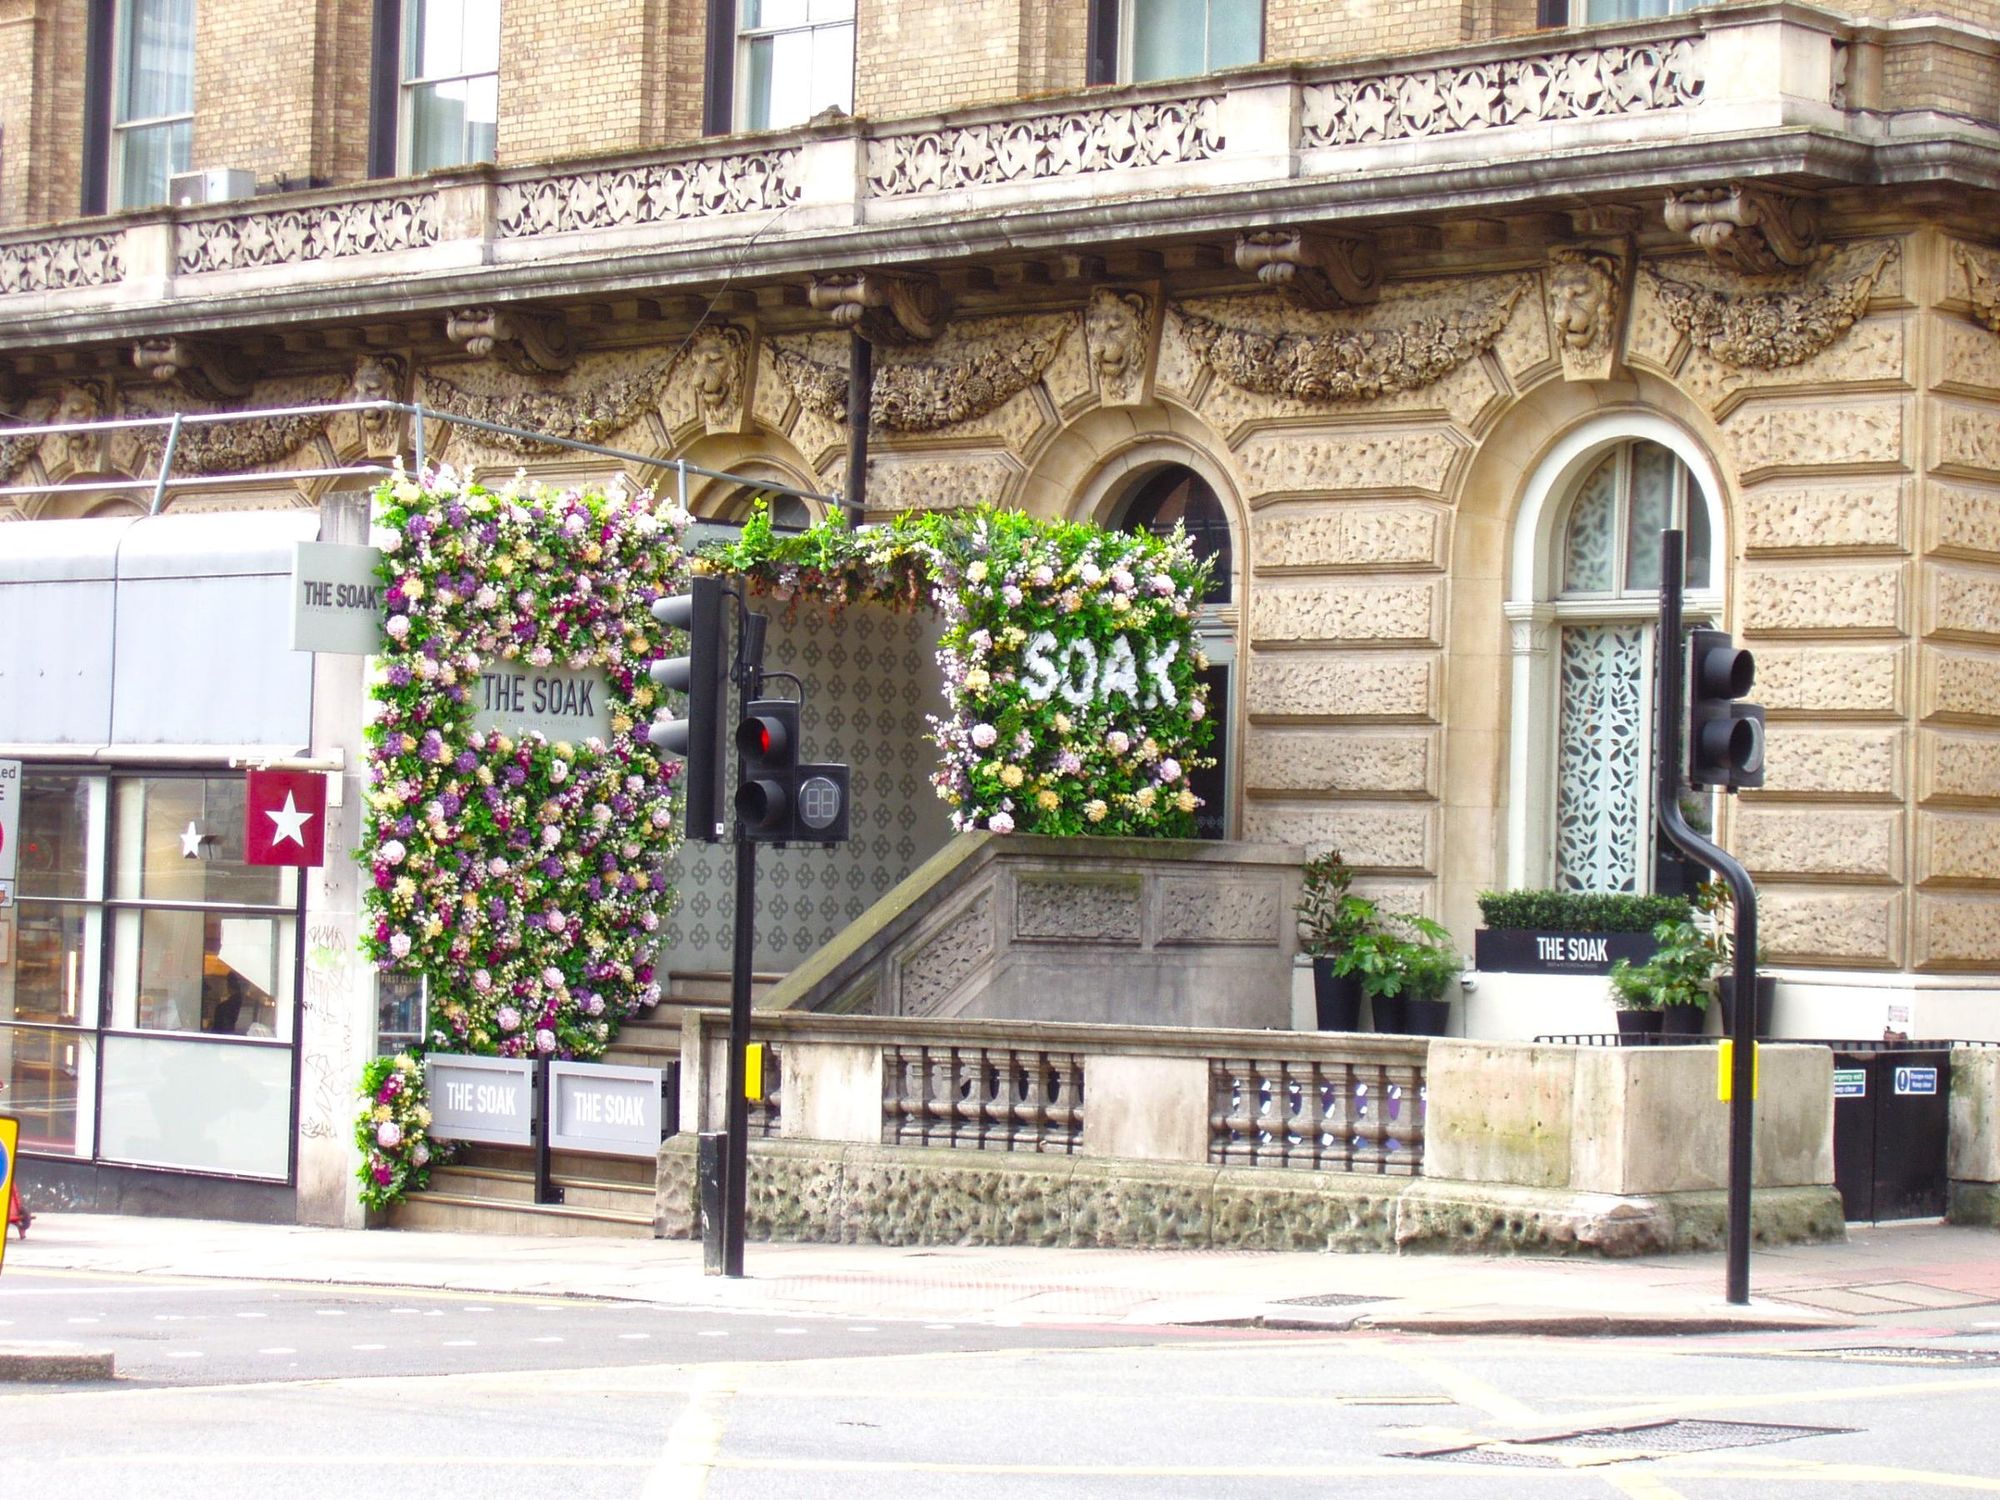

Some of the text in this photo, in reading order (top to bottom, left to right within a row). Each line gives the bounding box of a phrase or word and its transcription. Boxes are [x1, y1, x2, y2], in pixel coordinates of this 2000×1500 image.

[303, 580, 377, 610] THE SOAK
[1021, 629, 1180, 710] SOAK
[482, 672, 595, 717] THE SOAK
[1536, 936, 1609, 962] THE SOAK
[446, 1082, 516, 1115] THE SOAK
[573, 1091, 645, 1126] THE SOAK
